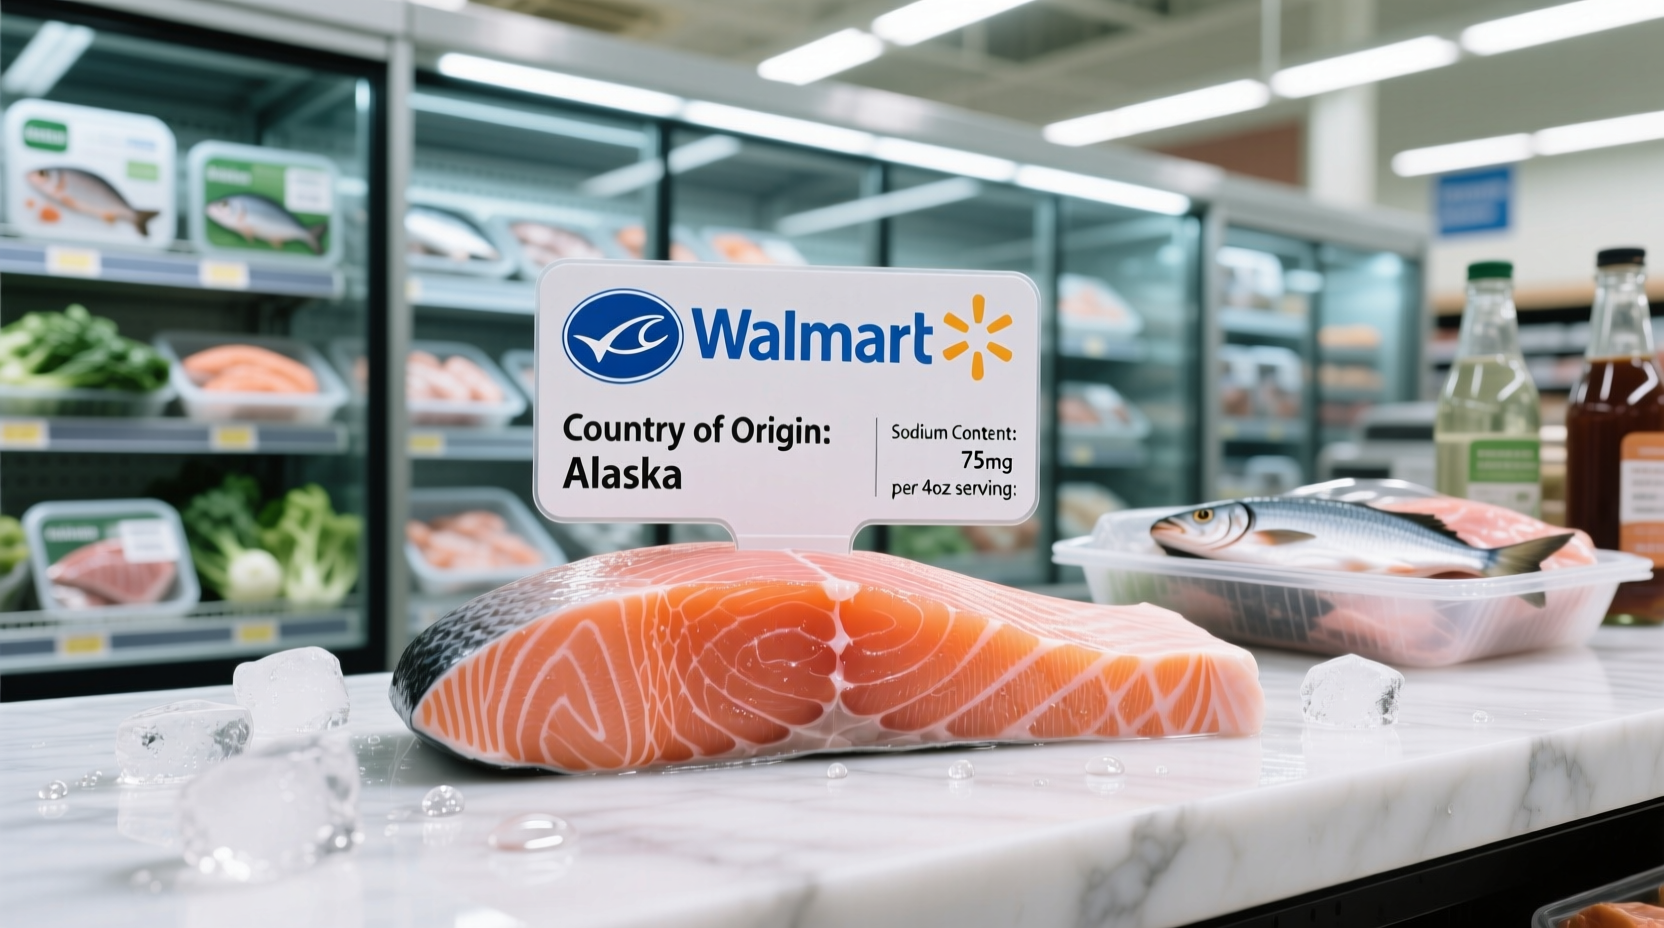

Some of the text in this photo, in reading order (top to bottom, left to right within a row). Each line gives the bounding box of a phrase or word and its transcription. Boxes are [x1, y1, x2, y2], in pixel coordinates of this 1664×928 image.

[691, 308, 933, 364] Walmart
[563, 413, 830, 451] Country of Origin:
[892, 423, 1016, 440] Sodium Content:
[563, 456, 681, 489] Alaska
[961, 450, 1012, 473] 75mg
[892, 479, 1016, 500] per 4oz serving:
